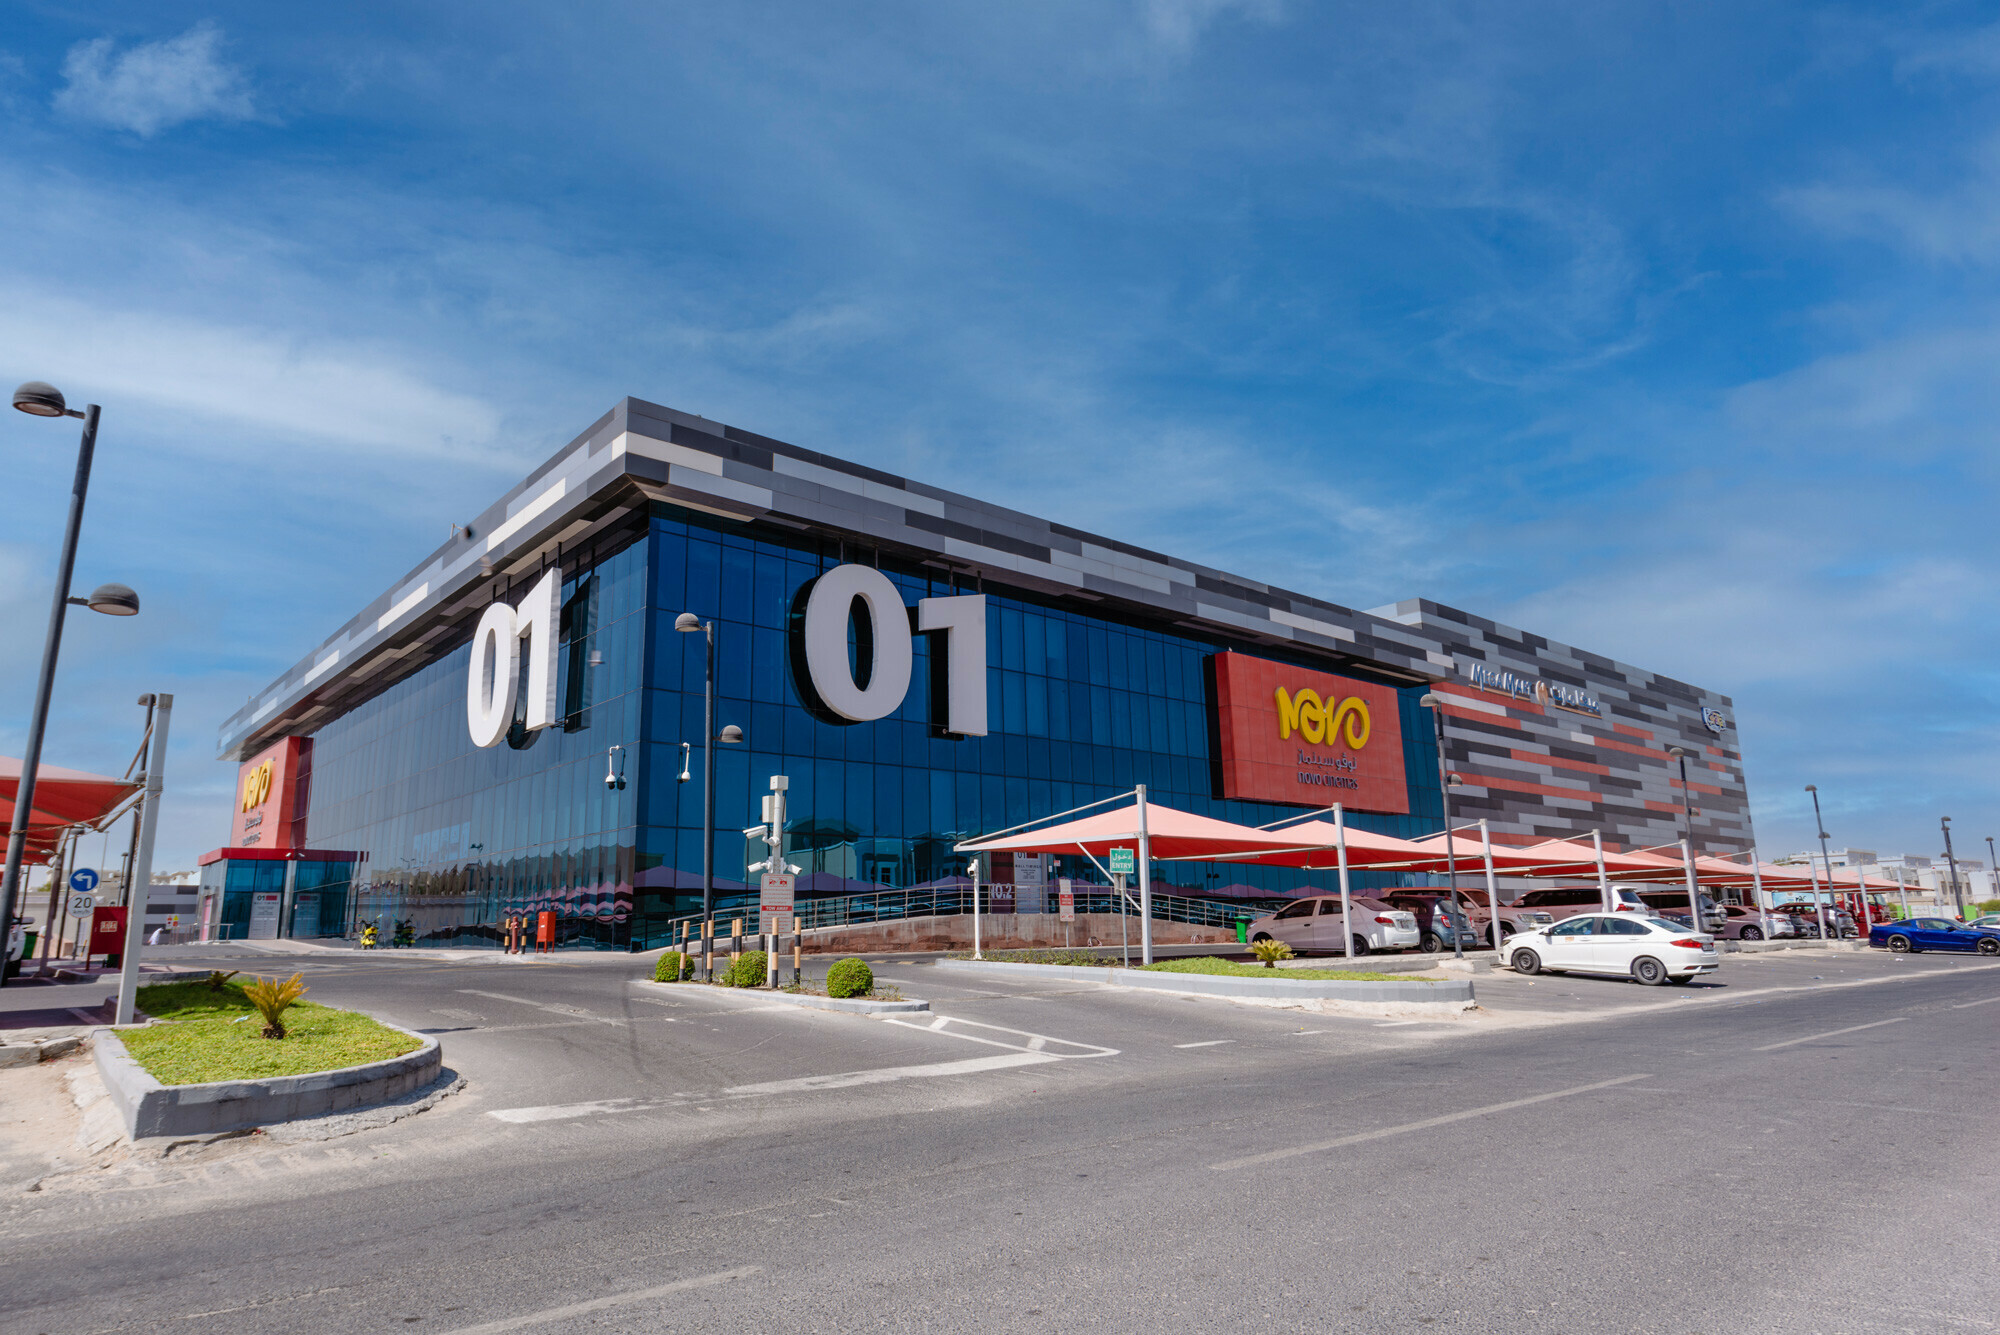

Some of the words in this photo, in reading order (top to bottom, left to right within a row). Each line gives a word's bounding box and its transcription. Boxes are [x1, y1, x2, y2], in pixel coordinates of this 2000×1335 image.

[467, 567, 562, 748] 01
[805, 563, 987, 737] 01
[1298, 771, 1321, 786] novo
[1322, 771, 1359, 790] cinemas
[1112, 853, 1131, 861] دخول
[74, 897, 92, 909] 20
